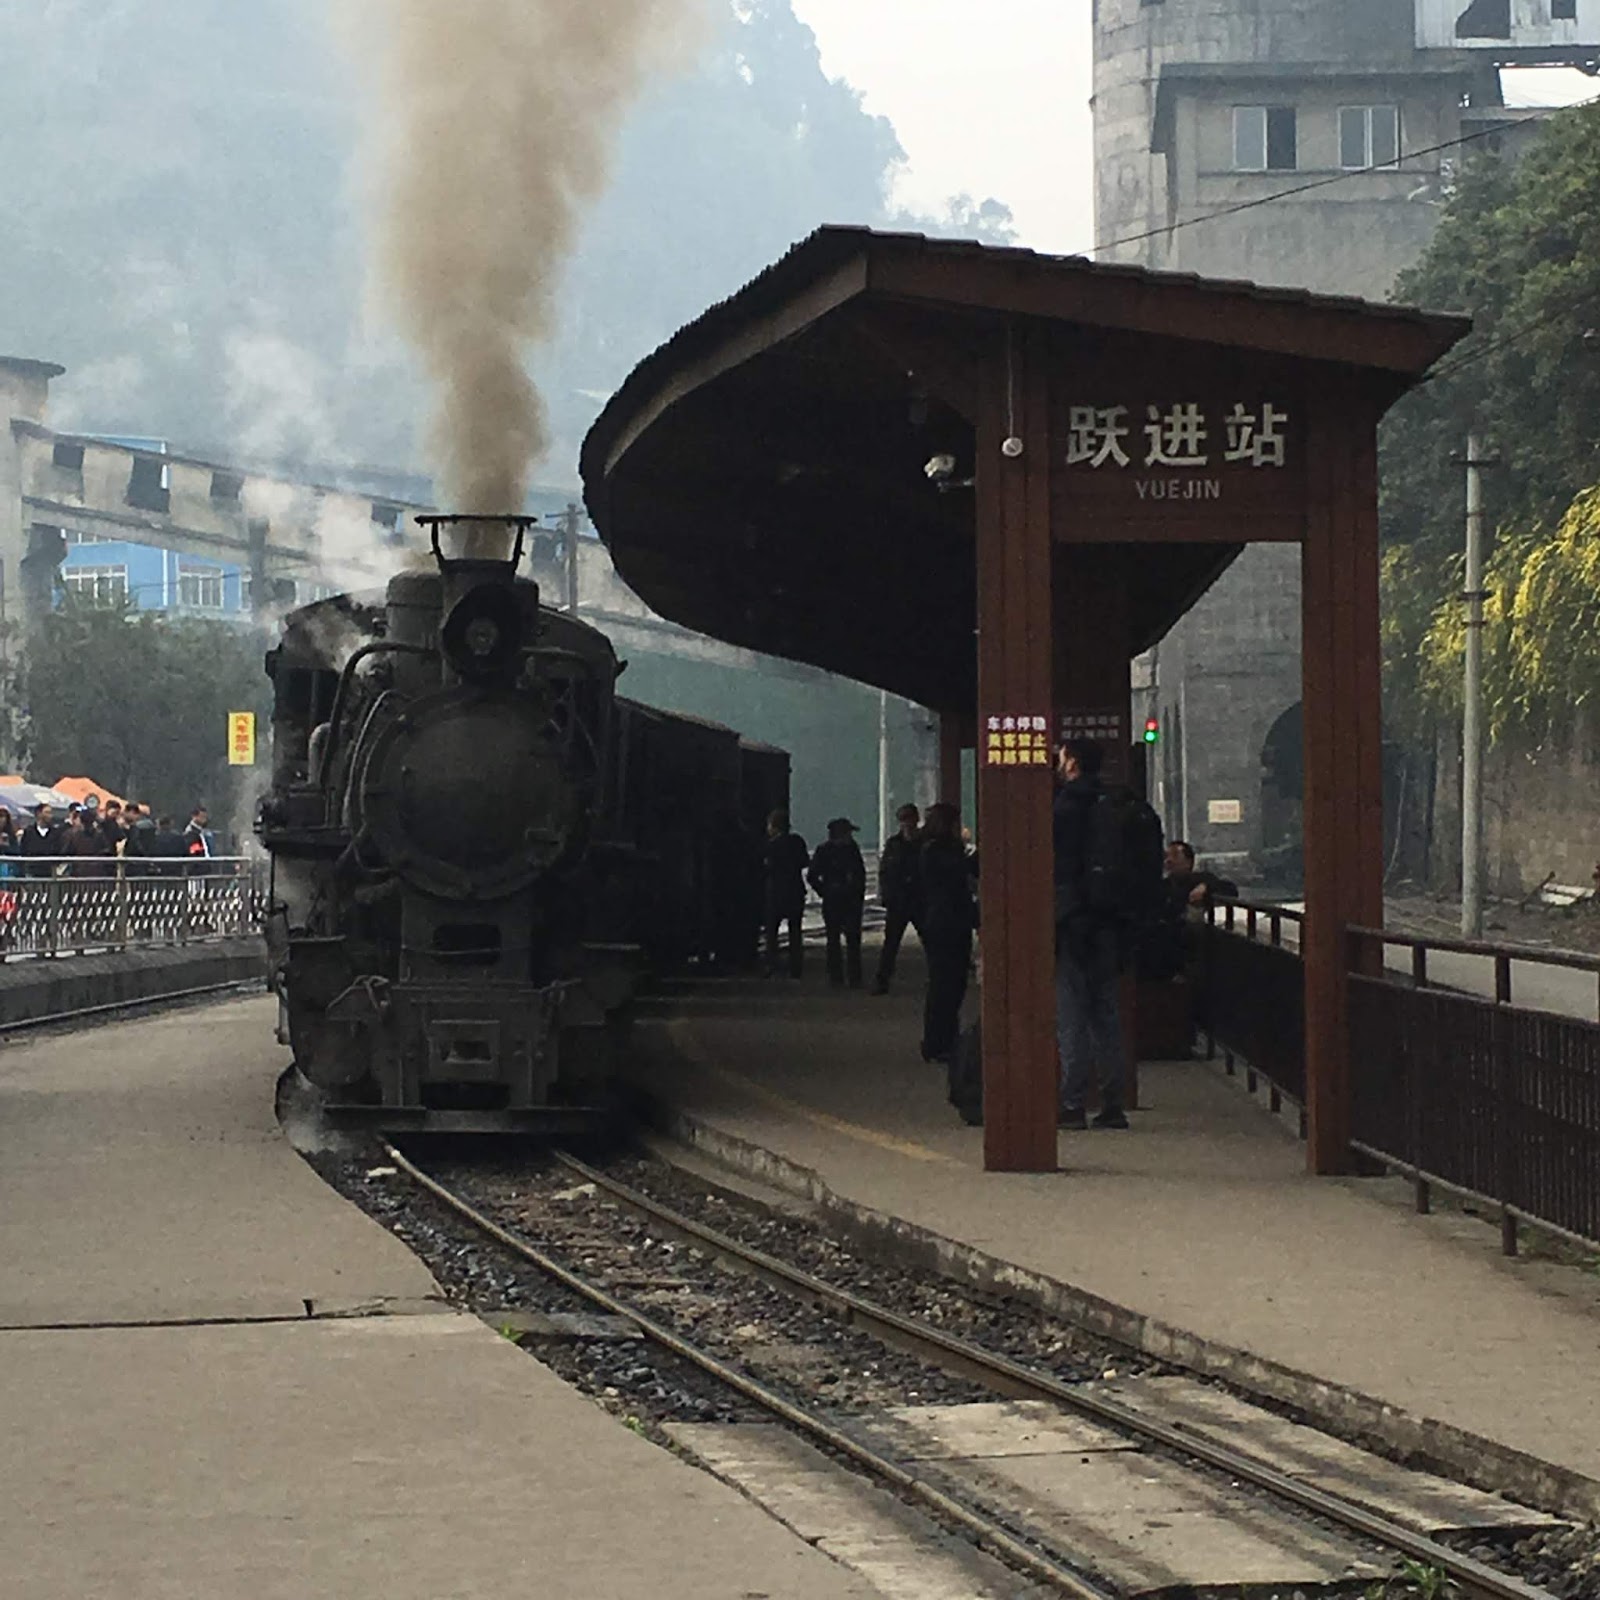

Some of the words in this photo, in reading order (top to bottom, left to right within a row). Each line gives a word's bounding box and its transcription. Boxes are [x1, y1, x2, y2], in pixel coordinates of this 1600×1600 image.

[1066, 402, 1288, 468] 跃进站
[1135, 479, 1221, 500] YUEJIN
[987, 715, 1047, 731] 车未停稳
